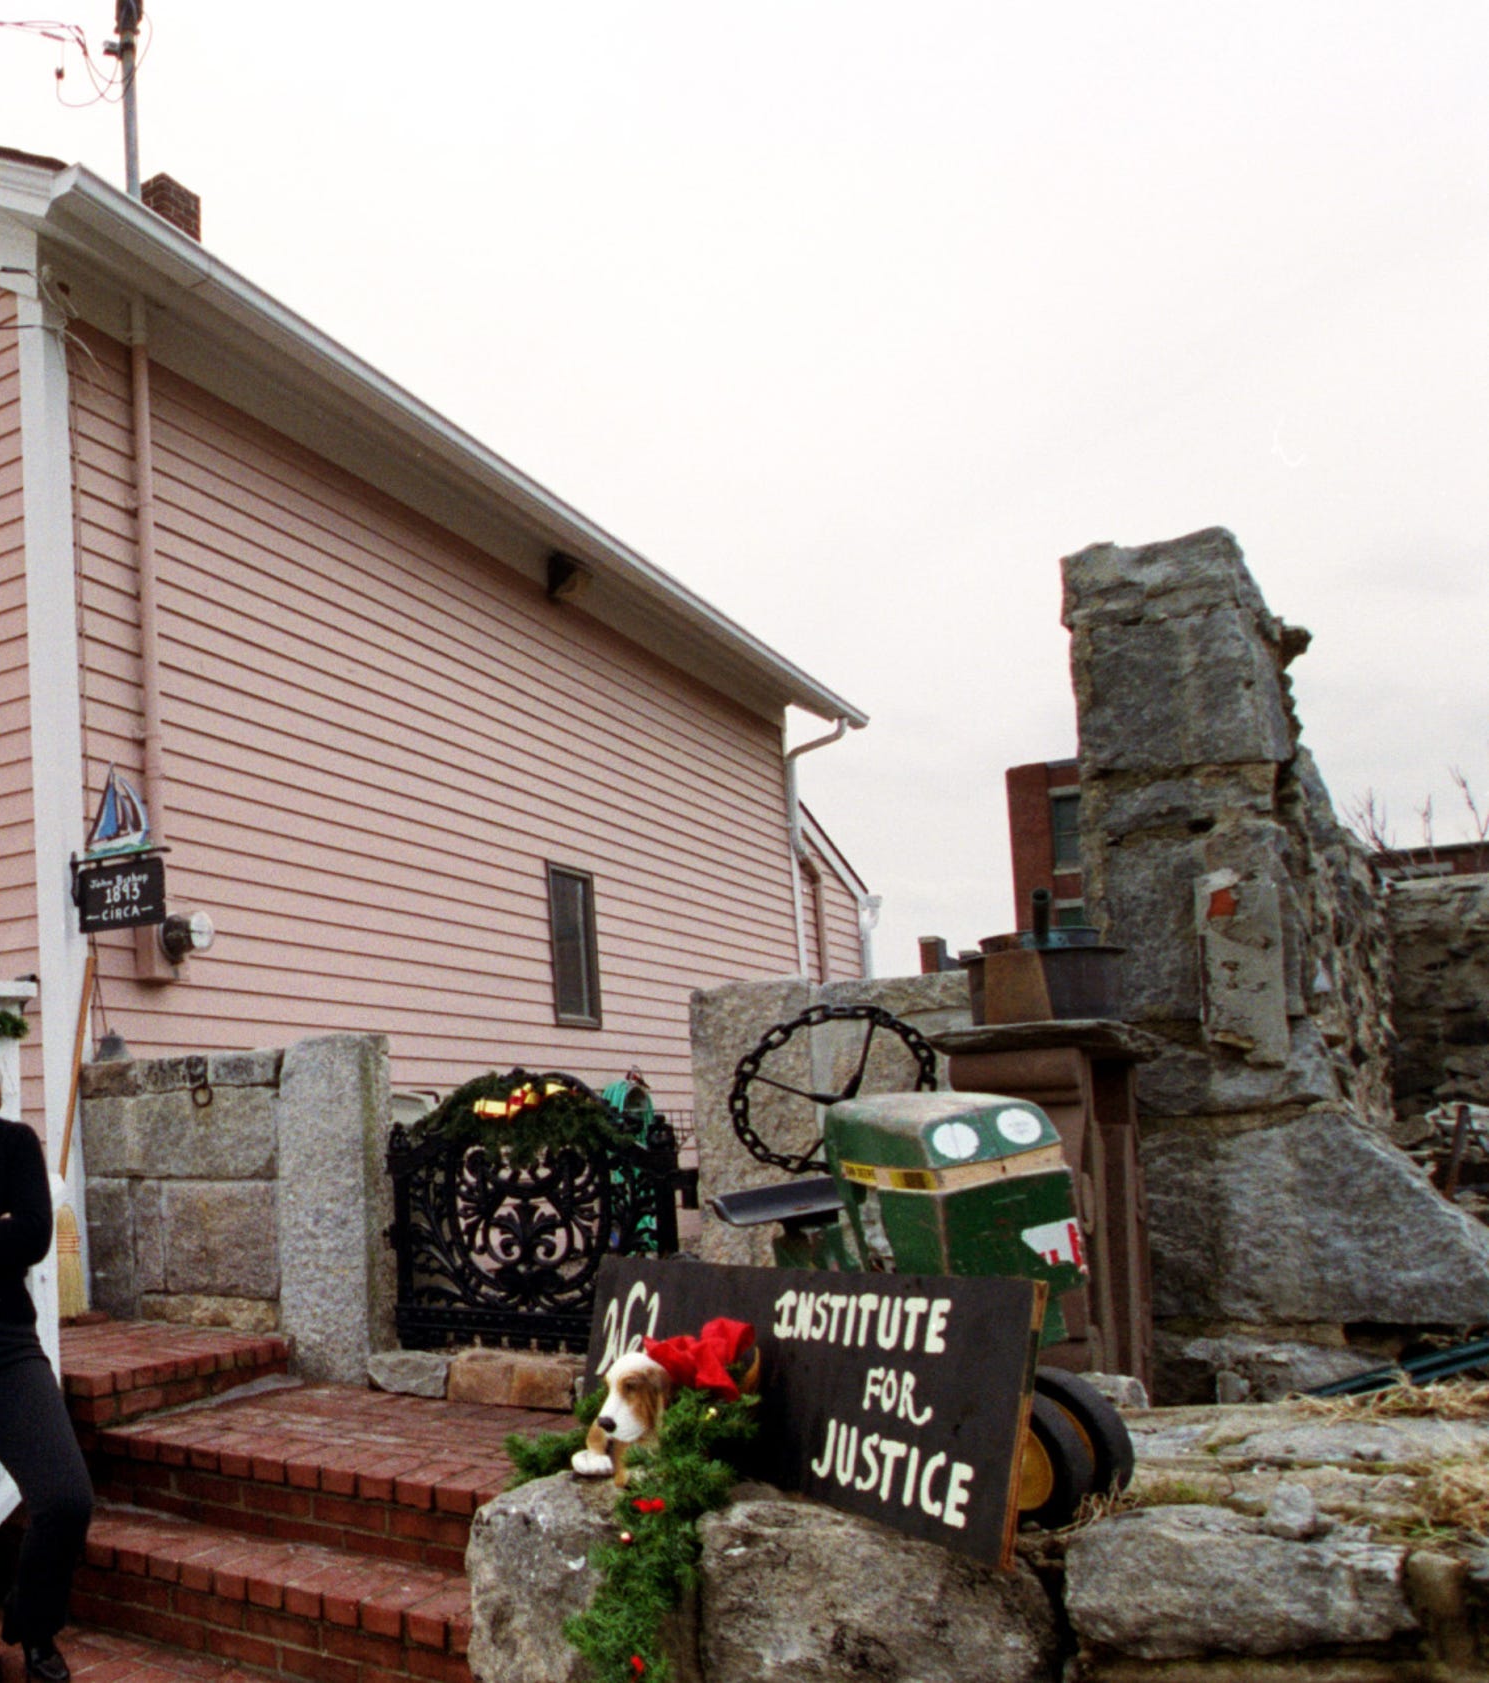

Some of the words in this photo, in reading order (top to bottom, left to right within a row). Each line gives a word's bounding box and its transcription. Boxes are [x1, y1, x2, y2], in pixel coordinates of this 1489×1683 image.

[774, 1290, 951, 1353] INSTITUTE
[862, 1367, 933, 1426] FOR
[812, 1418, 974, 1529] JUSTICE
